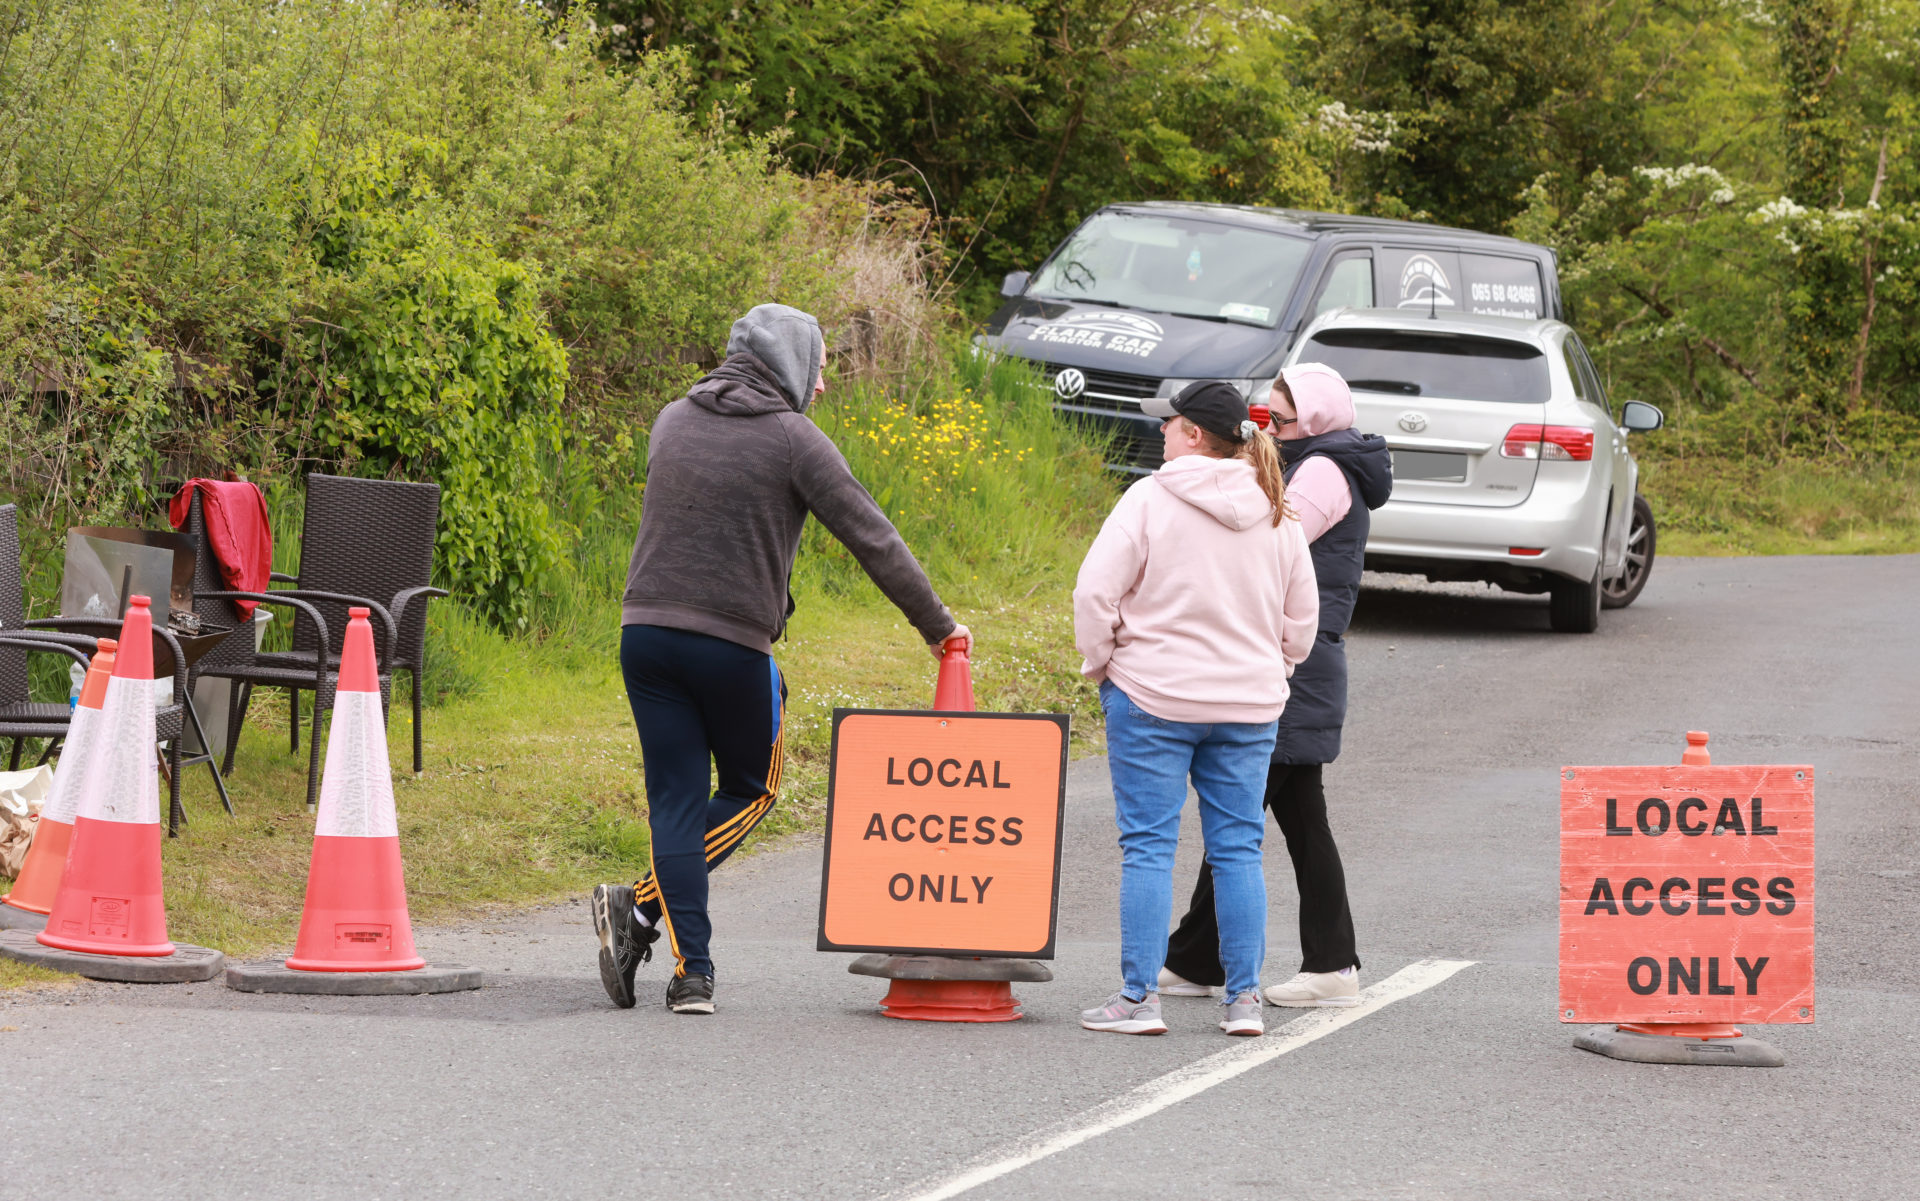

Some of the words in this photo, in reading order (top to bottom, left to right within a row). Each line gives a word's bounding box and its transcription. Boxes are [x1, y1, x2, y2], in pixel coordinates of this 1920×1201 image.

[1472, 283, 1491, 301] 065
[1492, 284, 1505, 302] 68
[1034, 326, 1105, 341] CLARE
[1111, 335, 1158, 351] CAR
[1043, 335, 1102, 348] TRACTOR
[1105, 343, 1151, 358] PARTS
[887, 757, 1011, 789] LOCAL
[863, 813, 1024, 846] ACCESS
[1605, 797, 1779, 837] LOCAL
[888, 872, 994, 904] ONLY
[1583, 877, 1797, 916] ACCESS
[1626, 956, 1770, 996] ONLY
